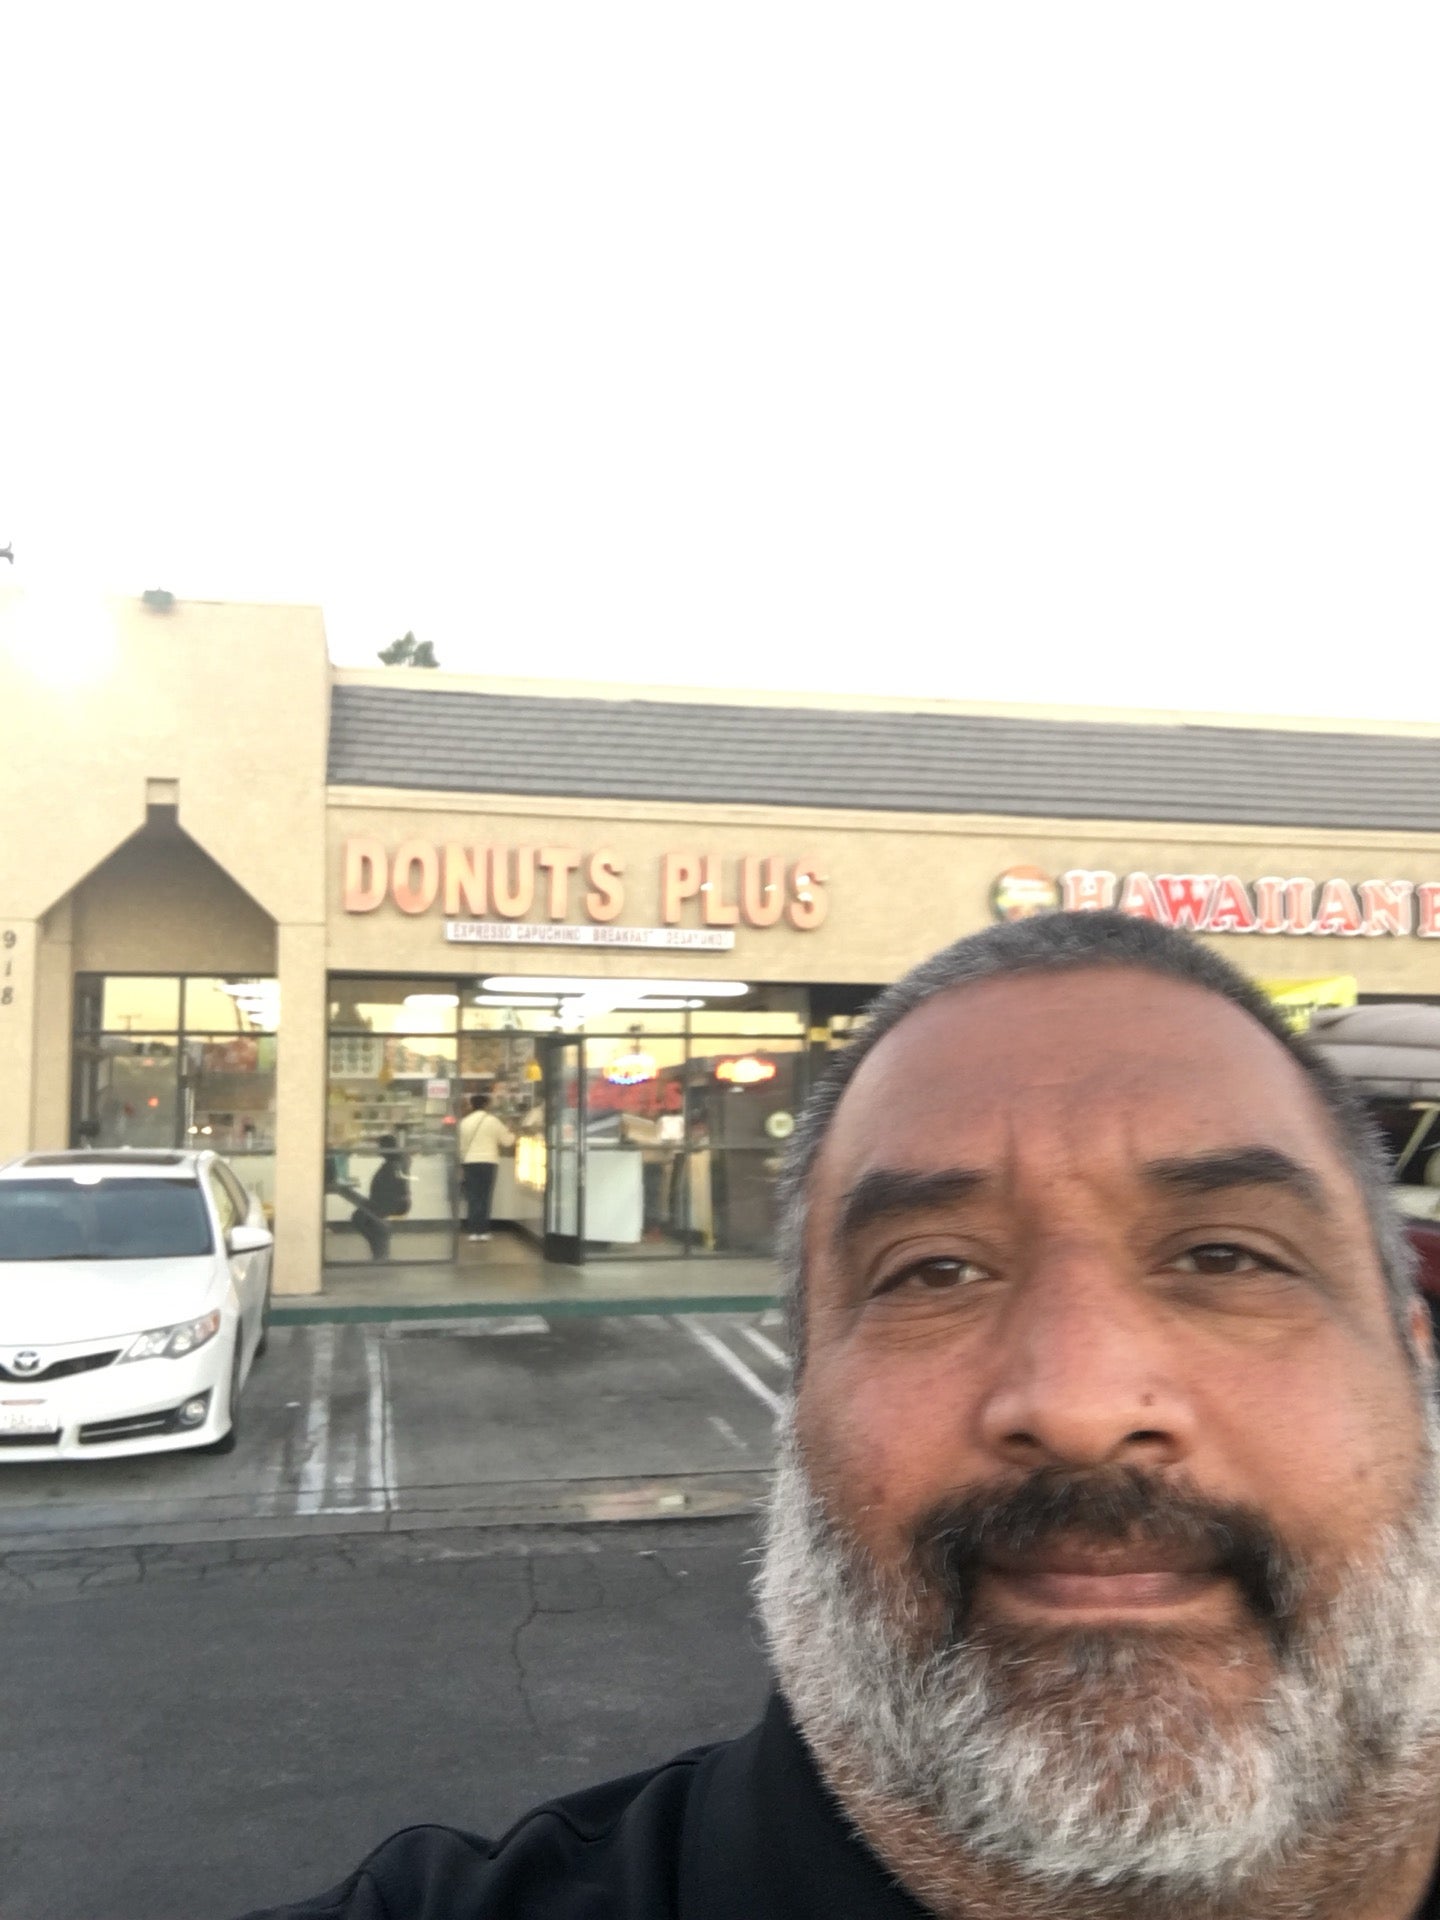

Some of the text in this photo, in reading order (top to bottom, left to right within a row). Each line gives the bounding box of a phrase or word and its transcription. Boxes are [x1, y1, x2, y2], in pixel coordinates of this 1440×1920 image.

[343, 837, 829, 930] DONUTS PLUS
[1062, 868, 1413, 936] HAWAIIAN
